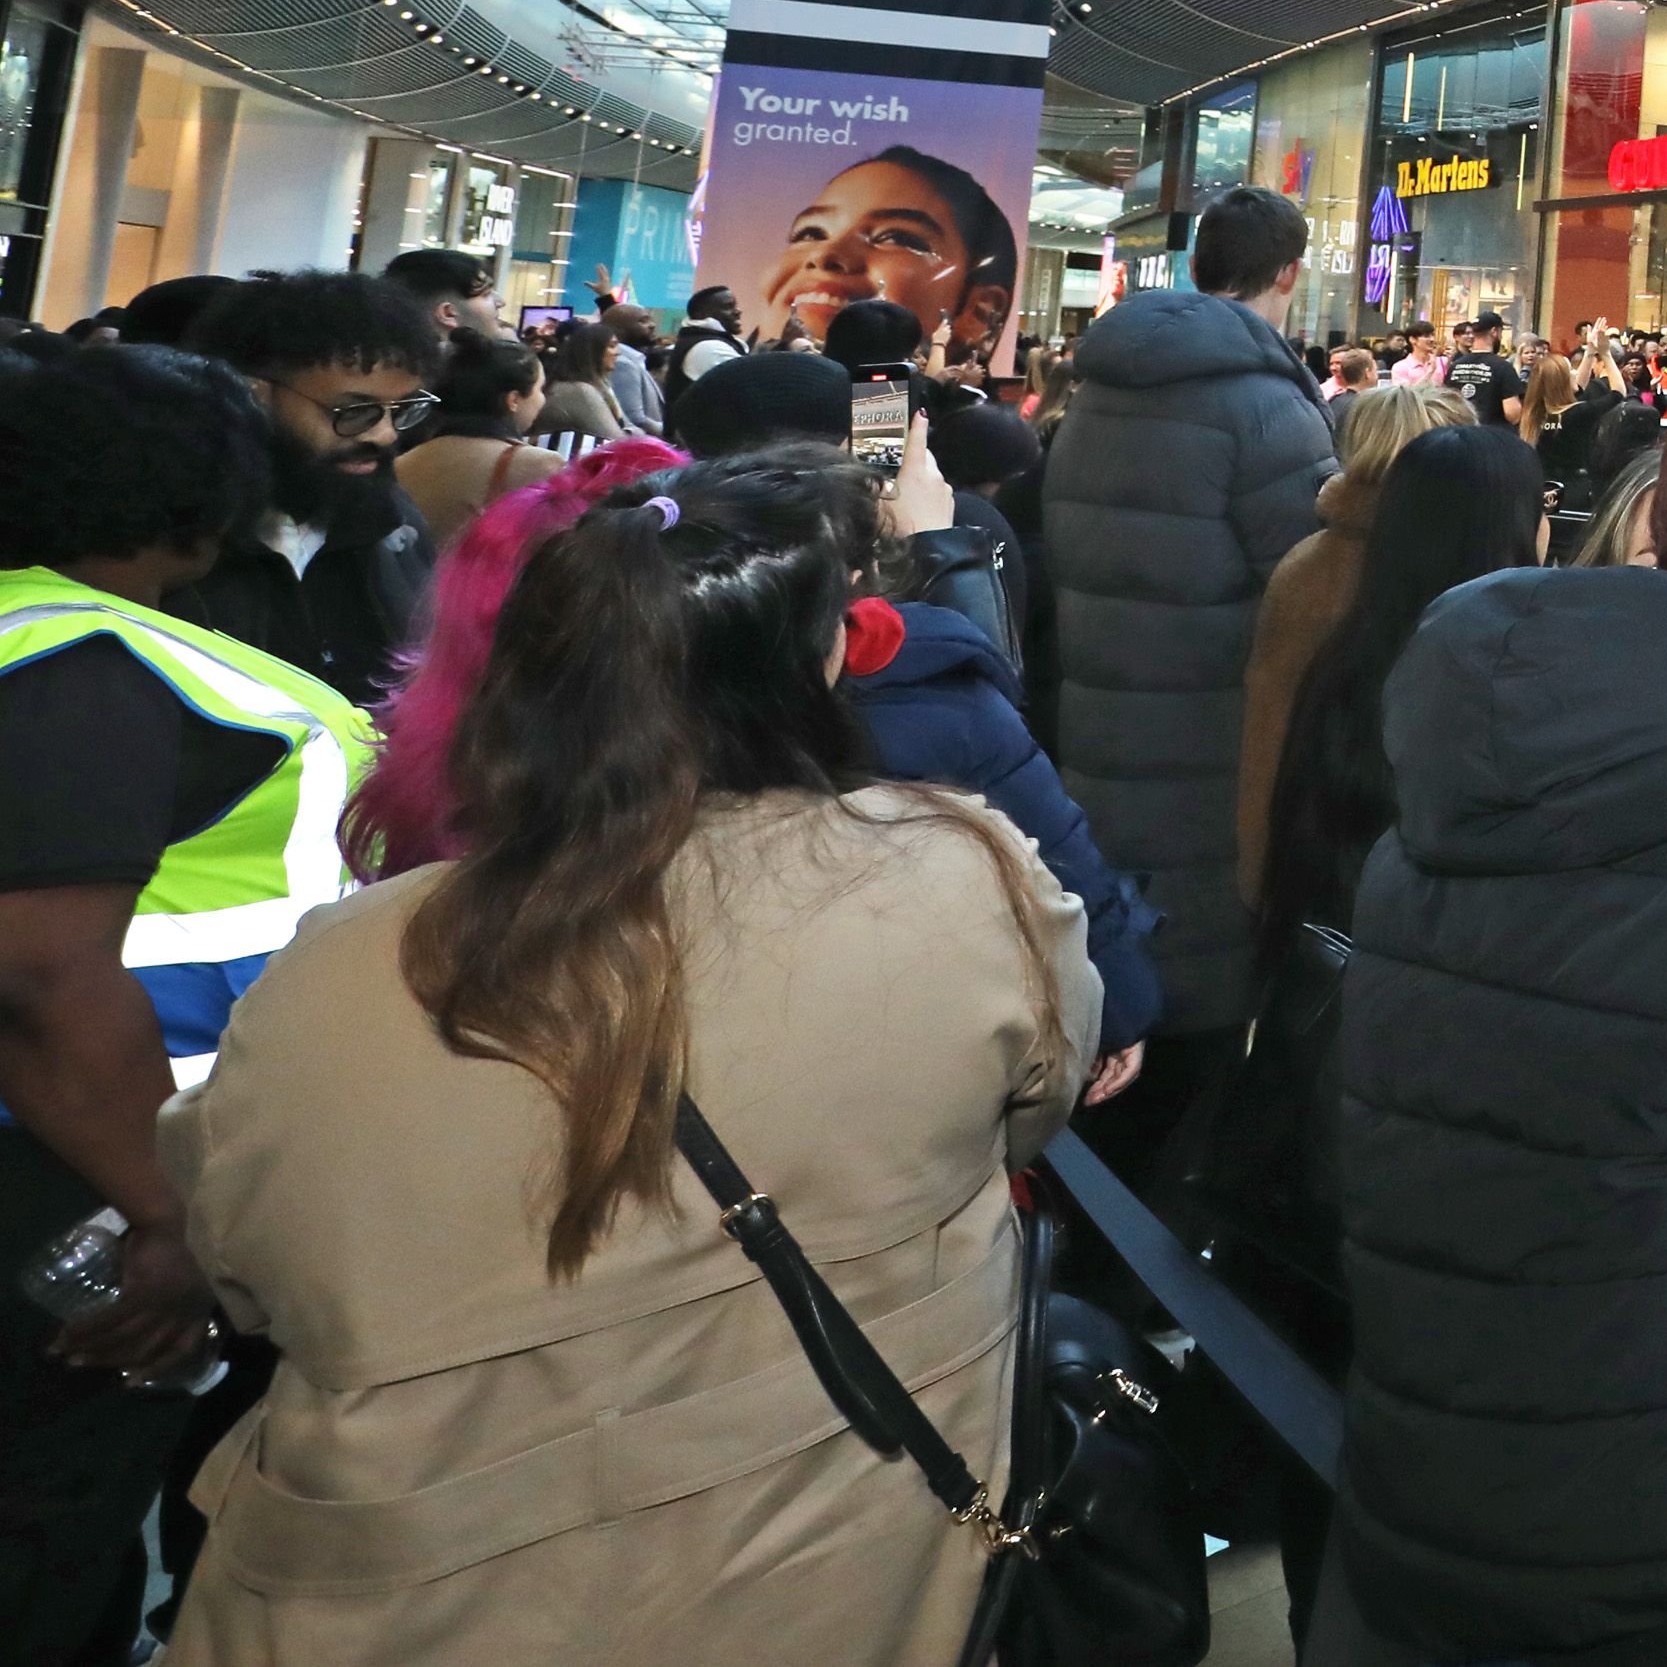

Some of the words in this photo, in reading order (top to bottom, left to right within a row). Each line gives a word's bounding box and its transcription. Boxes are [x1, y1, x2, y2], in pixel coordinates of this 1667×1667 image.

[738, 86, 822, 117] Your
[830, 95, 909, 122] wish
[733, 120, 858, 146] granted.
